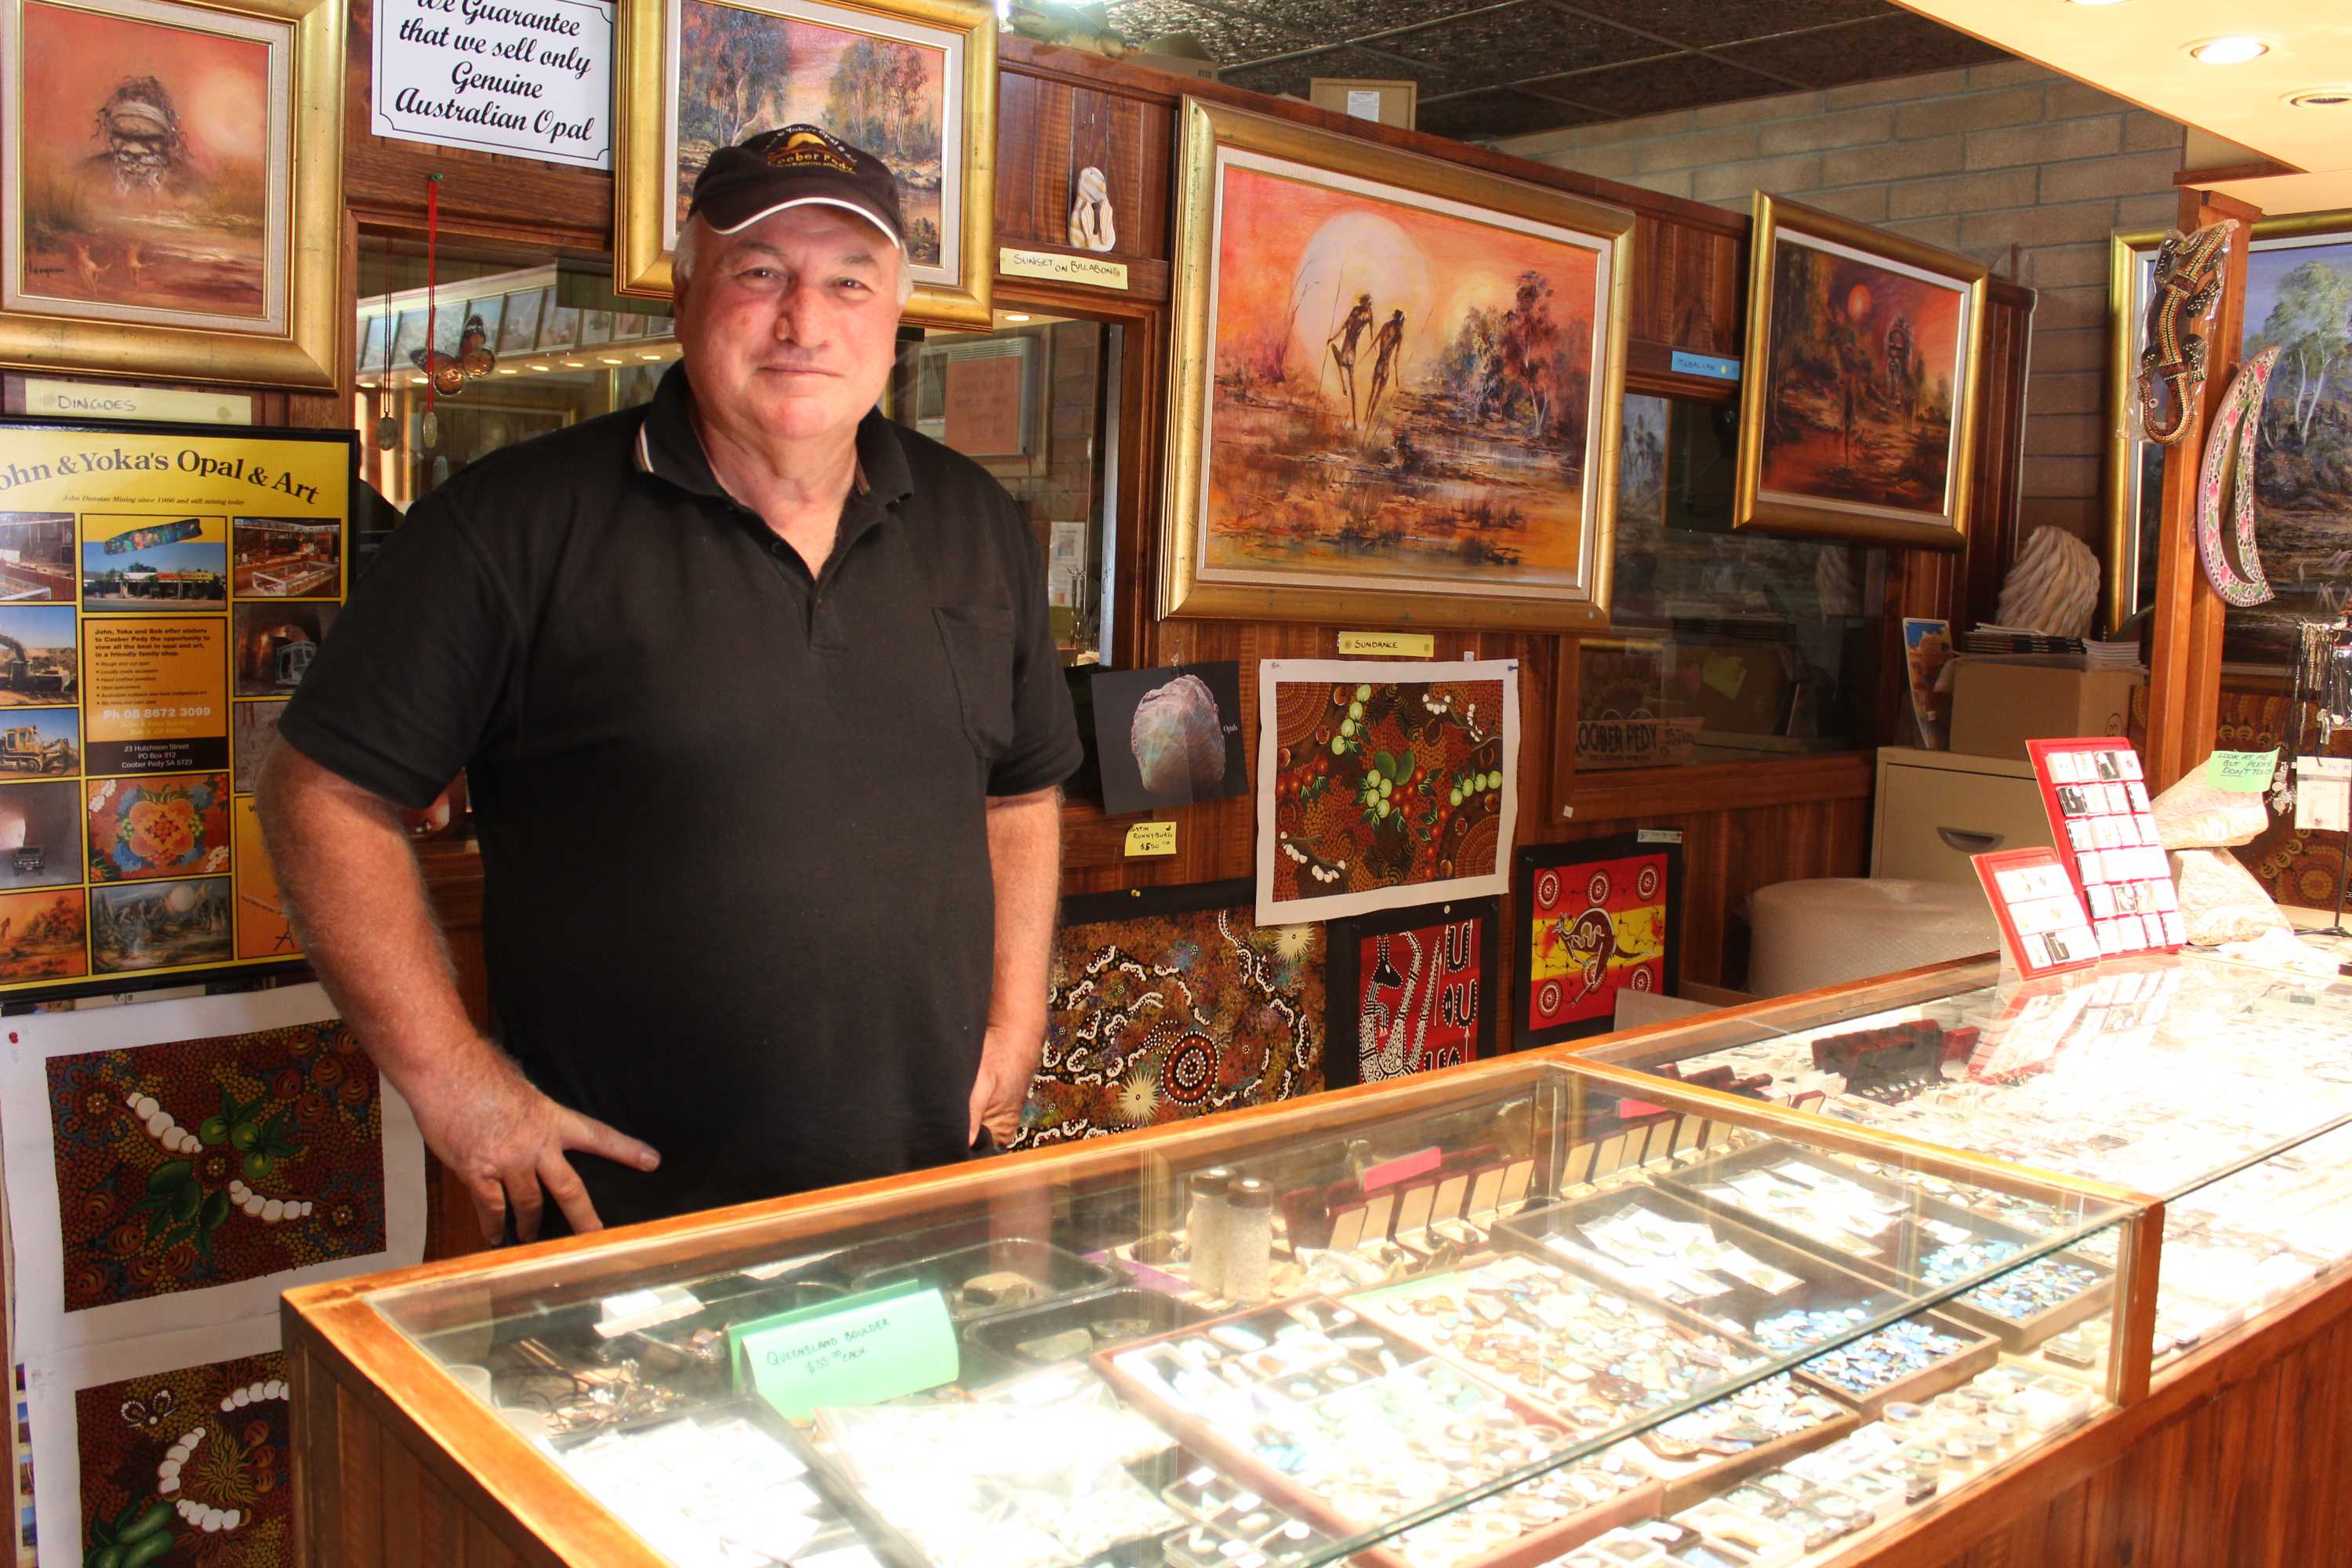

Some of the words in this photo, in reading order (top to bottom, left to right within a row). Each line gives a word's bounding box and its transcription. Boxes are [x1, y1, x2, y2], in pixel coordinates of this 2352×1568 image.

[461, 0, 581, 37] Guarantee
[399, 17, 449, 47] that
[454, 34, 487, 53] we
[492, 37, 537, 63] sell
[540, 46, 591, 80] only
[452, 60, 543, 99] Genuine
[395, 87, 527, 131] Australian
[534, 109, 595, 143] Opal
[1014, 255, 1054, 267] SUNSET
[1071, 261, 1120, 276] BILLABONG
[57, 395, 136, 412] DINGOES
[0, 461, 52, 492] ohn
[57, 455, 78, 476] &
[79, 448, 169, 473] Yoka's
[176, 449, 243, 479] Opal
[248, 466, 268, 487] &
[271, 471, 320, 505] Art
[1355, 640, 1398, 649] SUNDANCE
[103, 710, 120, 720] Ph
[124, 710, 140, 719] 08
[143, 708, 176, 718] 8672
[180, 706, 212, 717] 3099
[134, 744, 169, 753] Hutchison
[1577, 722, 1624, 754] OOBER
[148, 760, 165, 769] Pedy
[767, 1338, 837, 1366] QUEENSLAND
[844, 1318, 890, 1341] BOULDER
[842, 1347, 866, 1363] EACH
